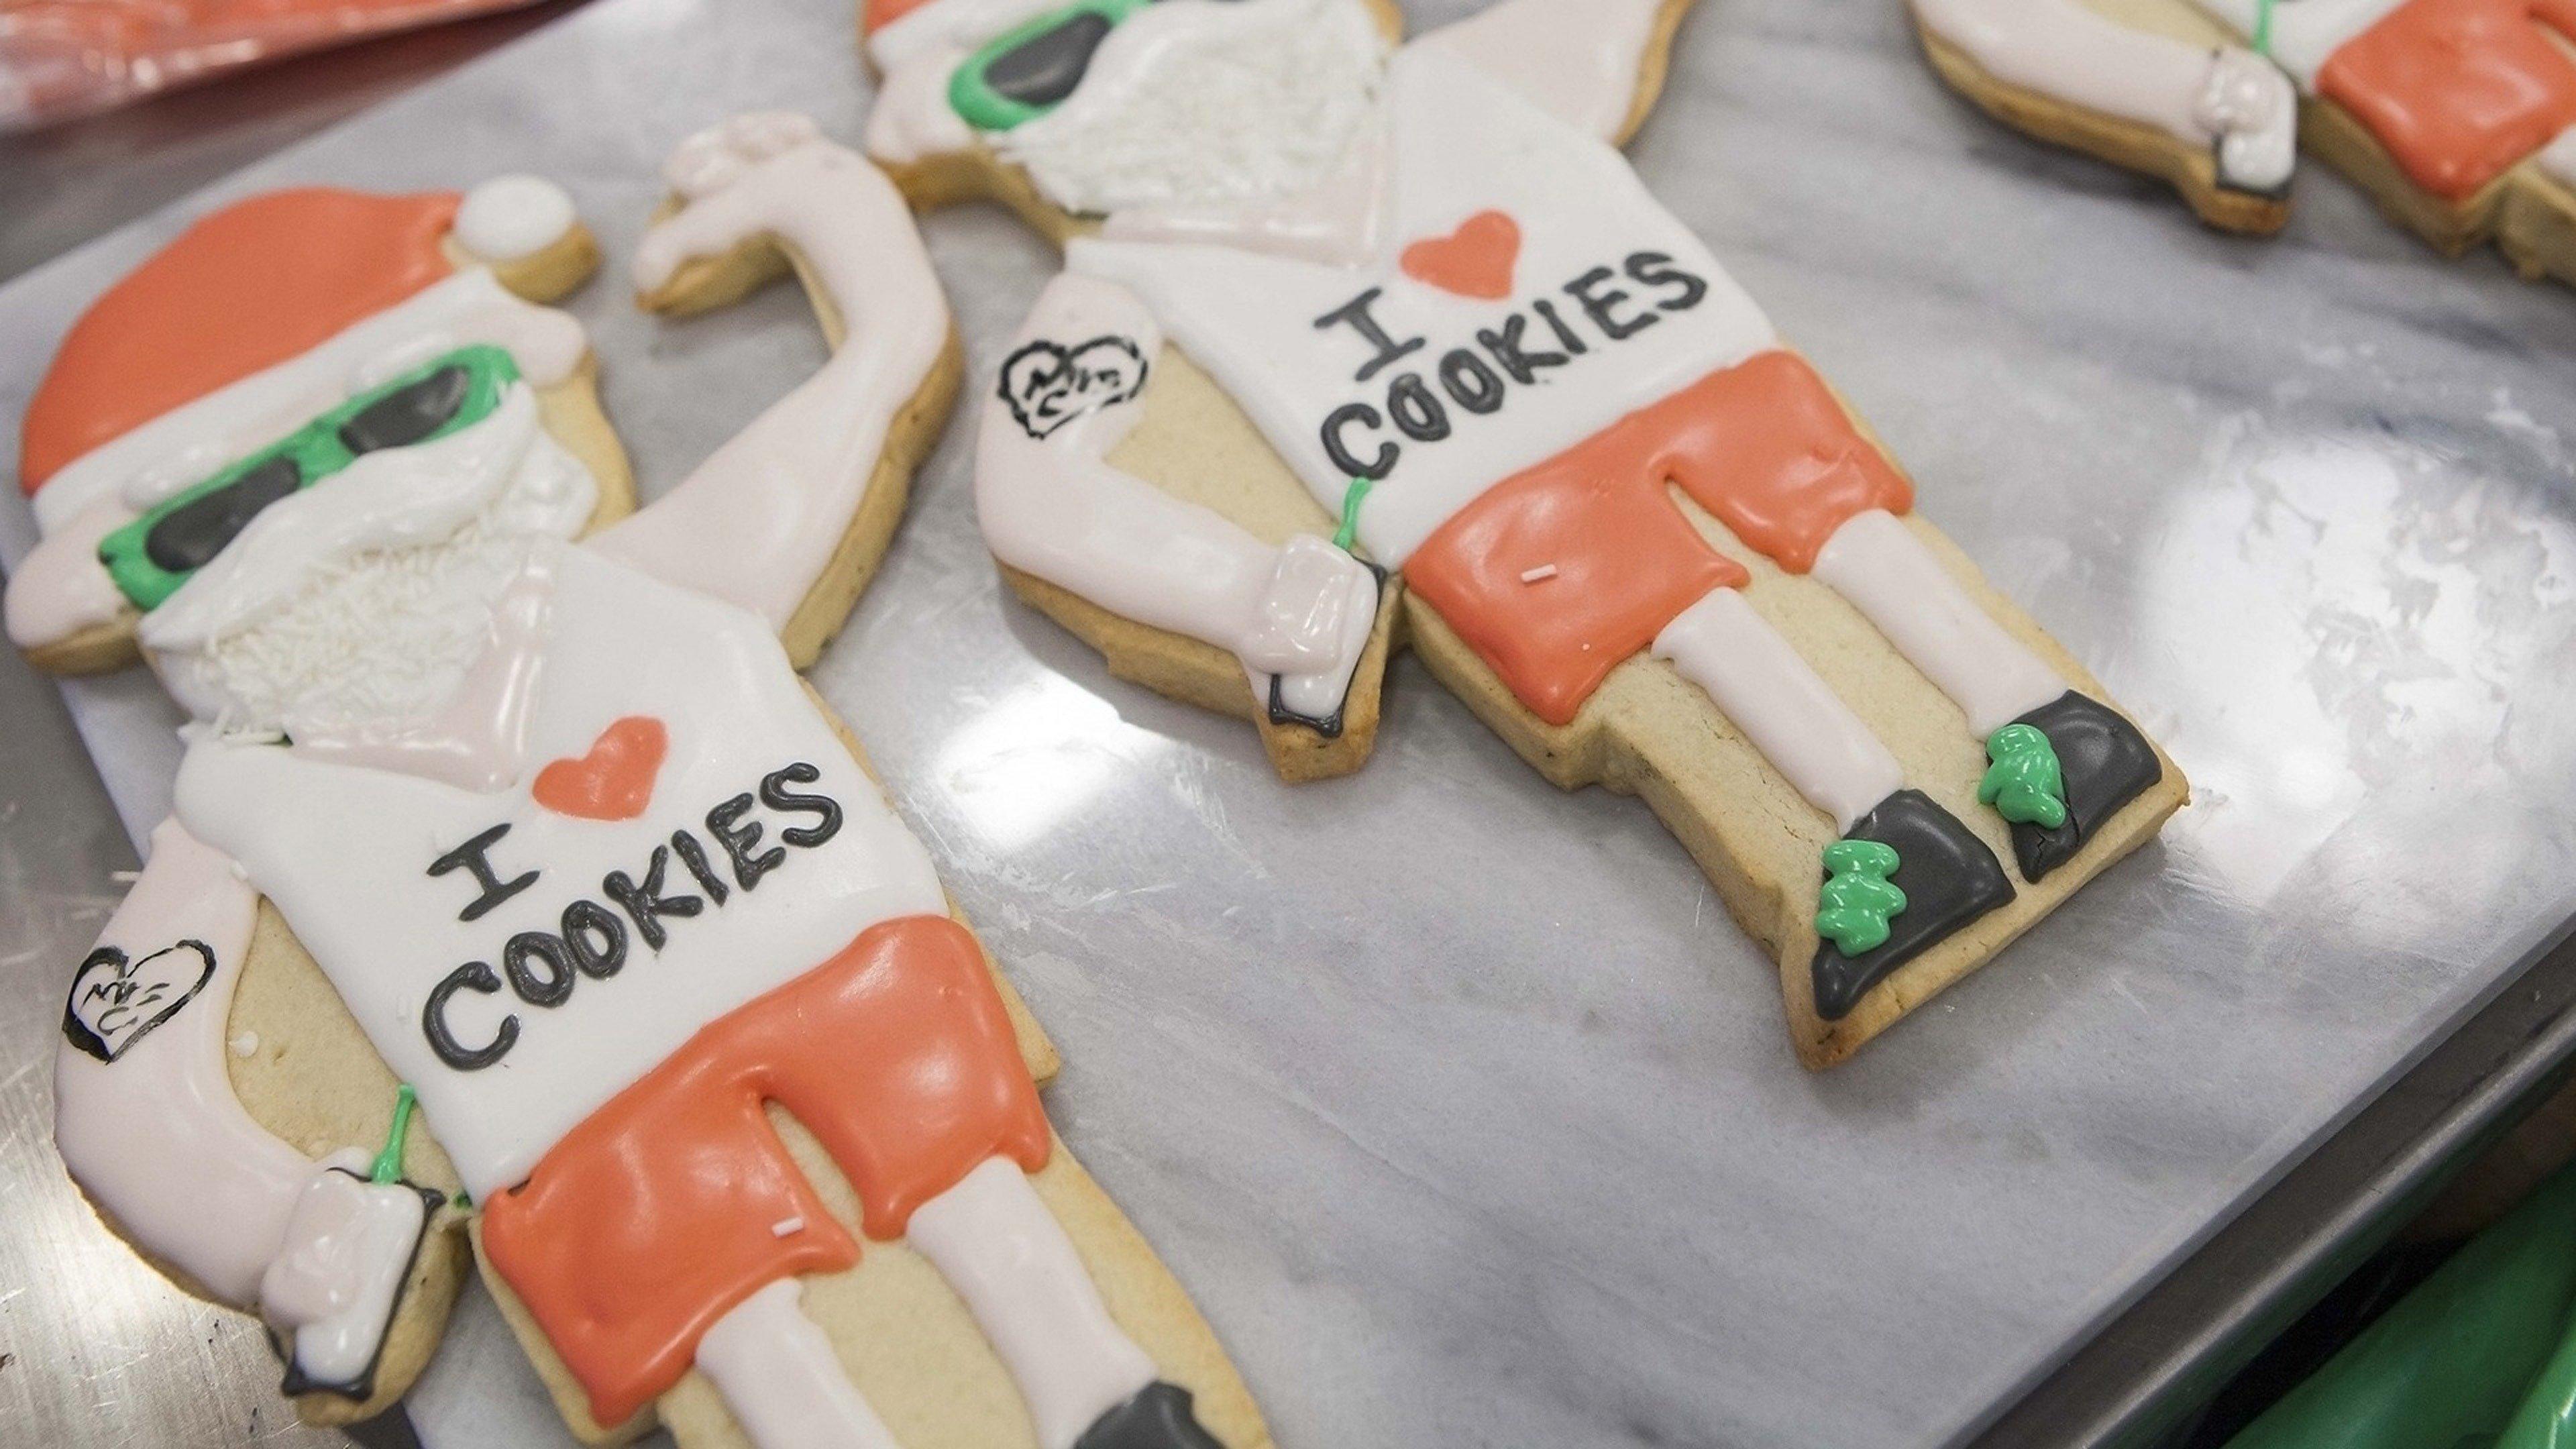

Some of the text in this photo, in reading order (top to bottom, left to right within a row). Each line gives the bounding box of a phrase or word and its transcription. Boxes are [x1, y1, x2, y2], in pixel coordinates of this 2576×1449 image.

[1312, 286, 1426, 382] I
[1320, 251, 1707, 481] COOKIES
[422, 761, 844, 1071] COOKIES
[425, 822, 541, 922] I
